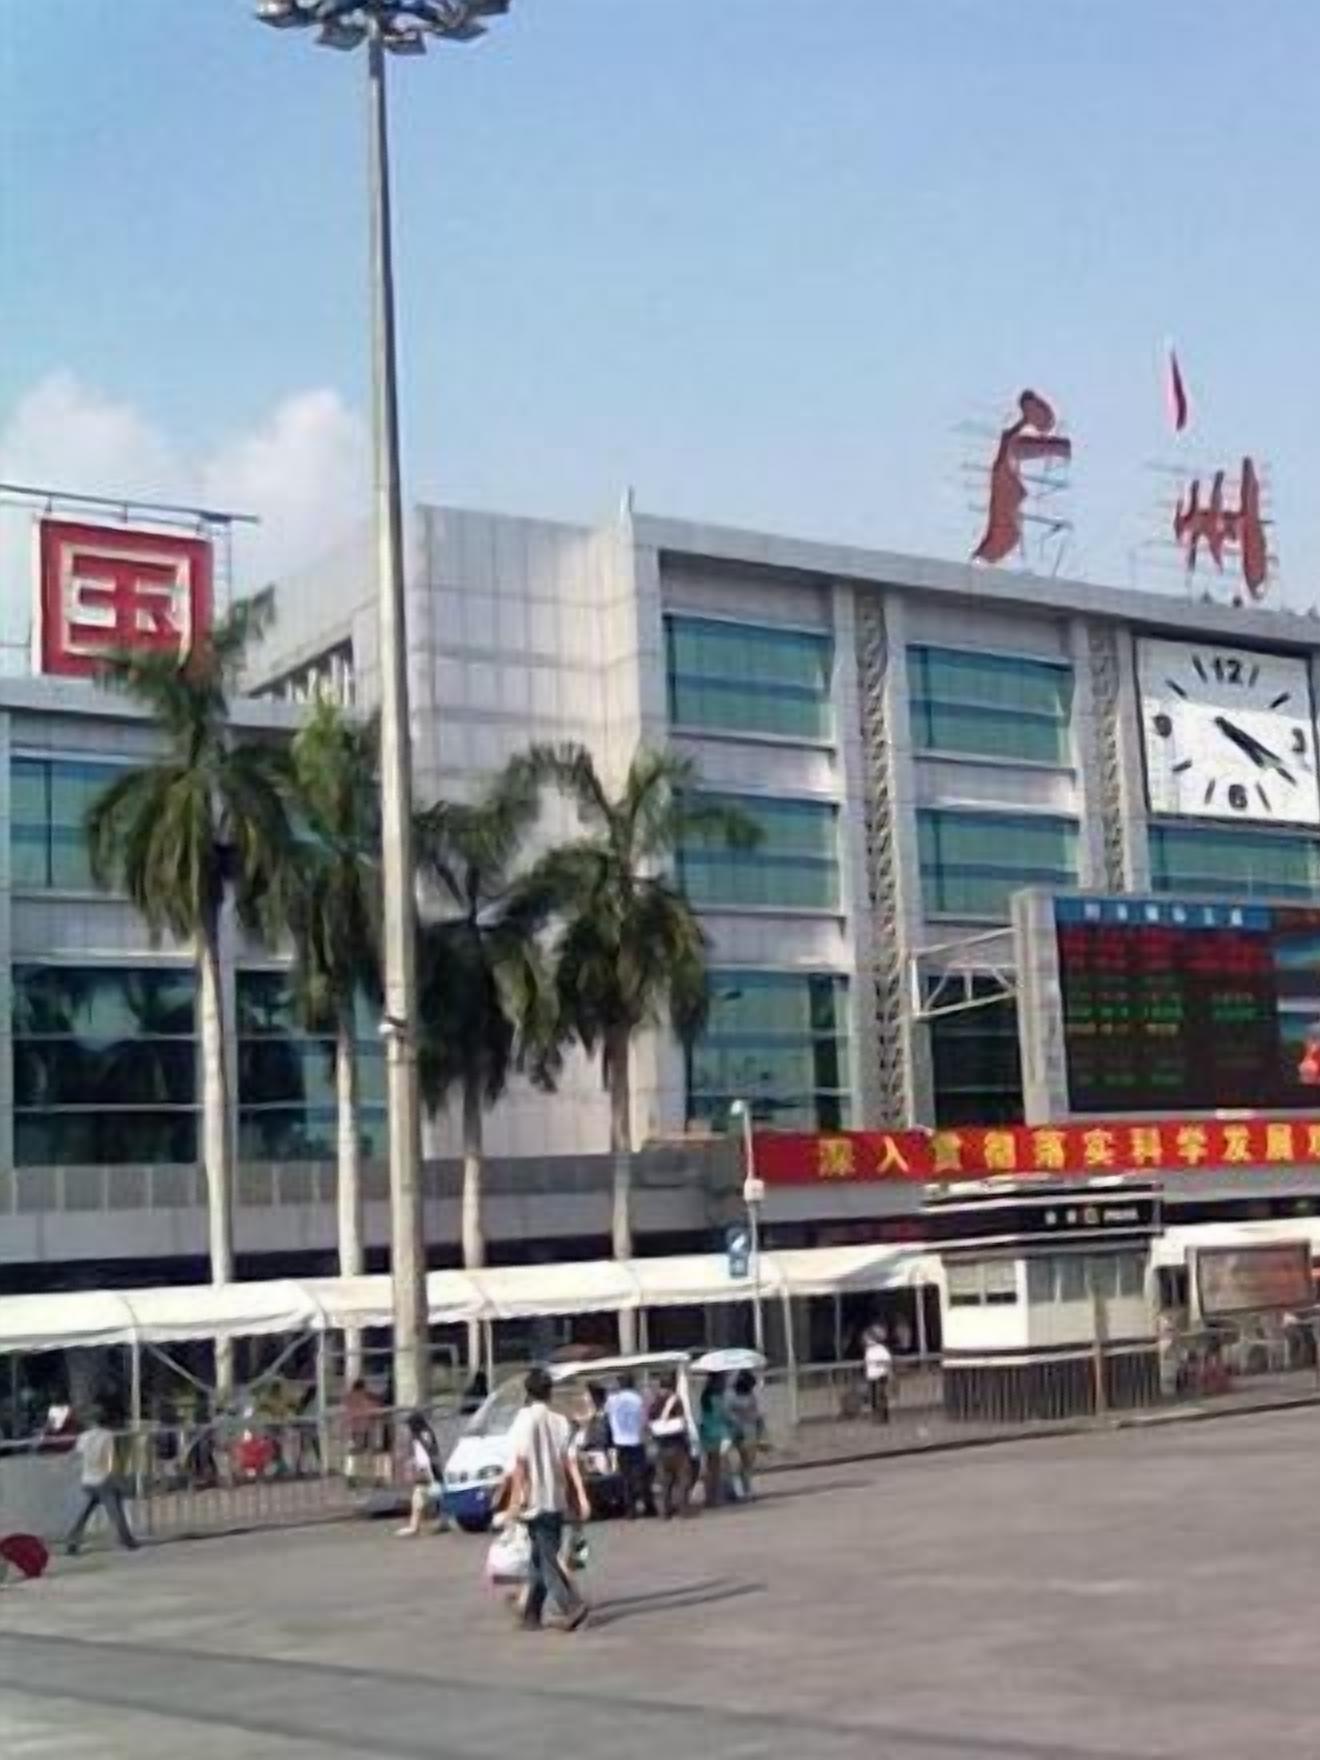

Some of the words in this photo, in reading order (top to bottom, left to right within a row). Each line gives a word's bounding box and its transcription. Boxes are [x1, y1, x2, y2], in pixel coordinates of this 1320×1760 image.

[40, 518, 214, 677] 国
[1214, 657, 1243, 685] 12
[1227, 783, 1248, 811] 6
